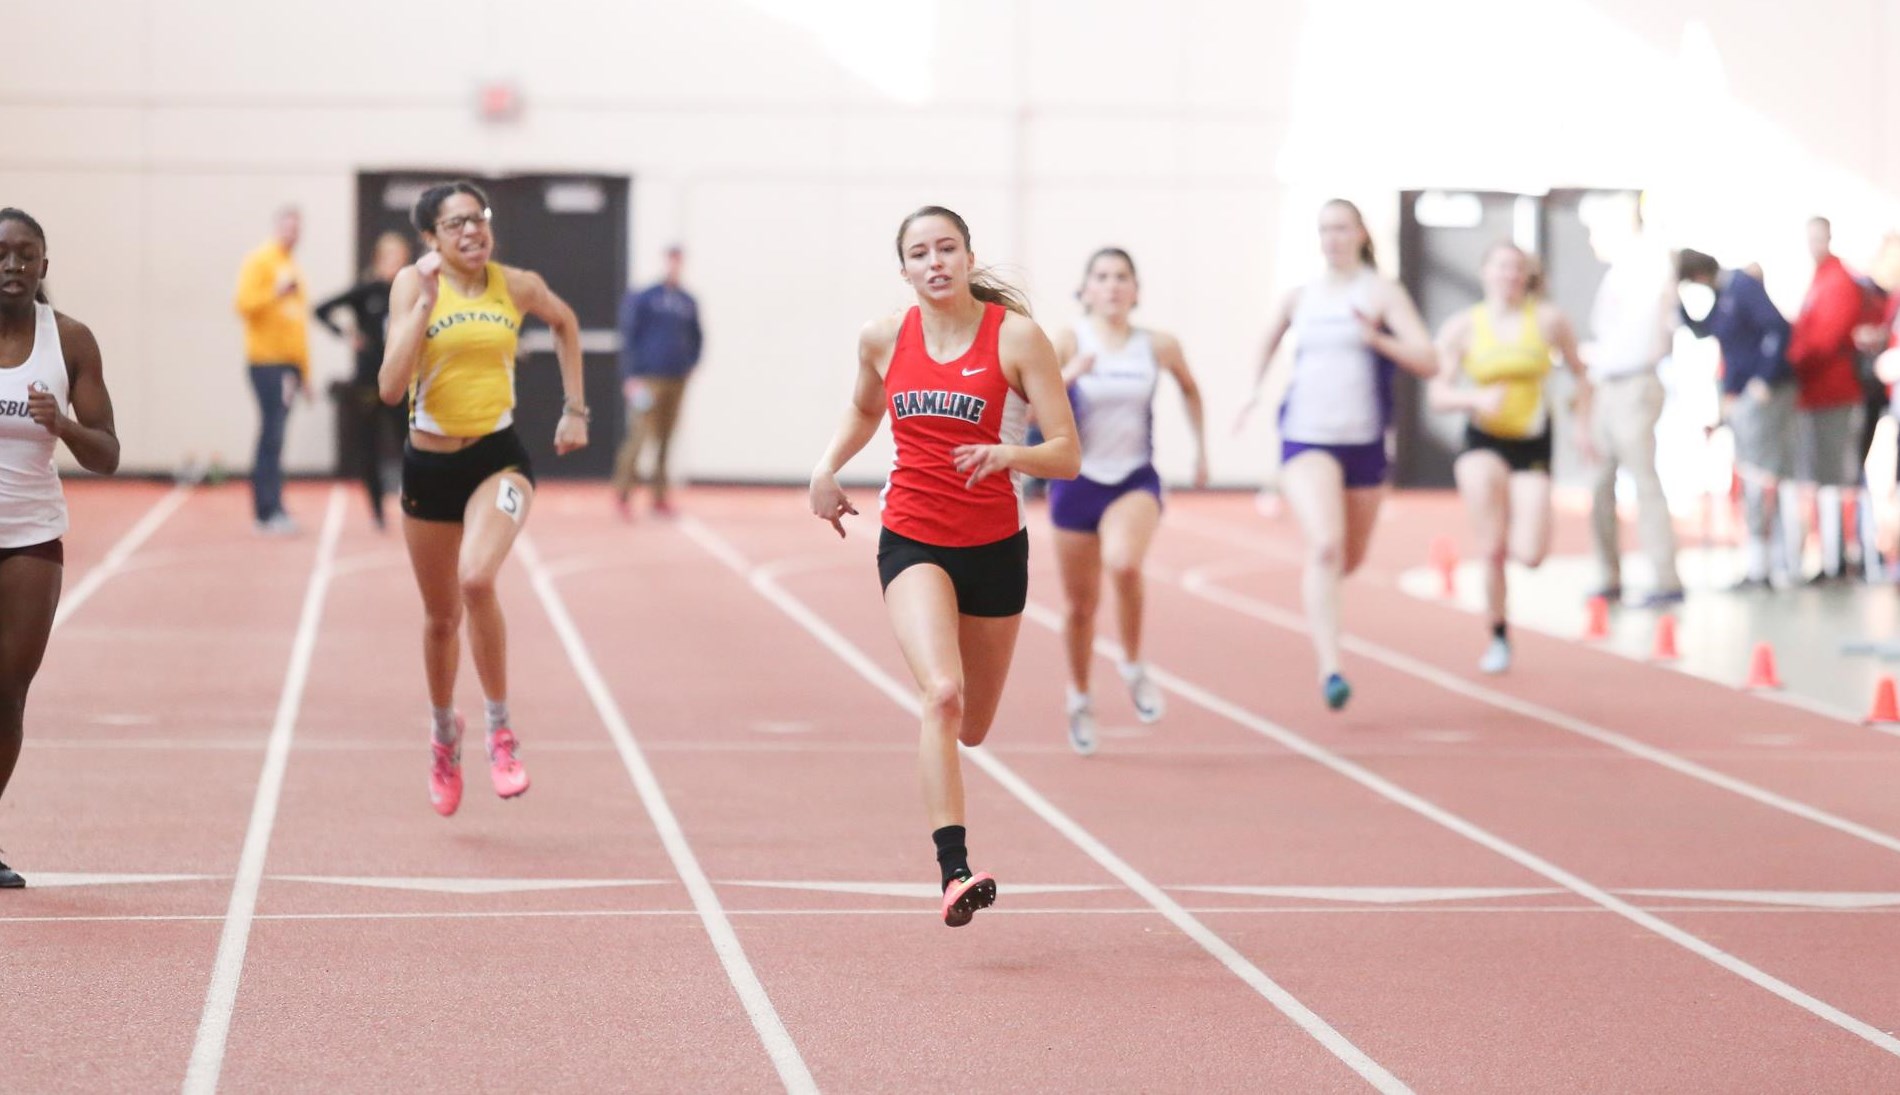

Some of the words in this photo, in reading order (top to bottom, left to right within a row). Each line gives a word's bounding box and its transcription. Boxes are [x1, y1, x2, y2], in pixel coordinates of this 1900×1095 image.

[425, 312, 518, 338] GUSTAVU
[0, 399, 31, 417] SBU
[892, 390, 987, 424] HAMLINE
[503, 486, 519, 514] 5
